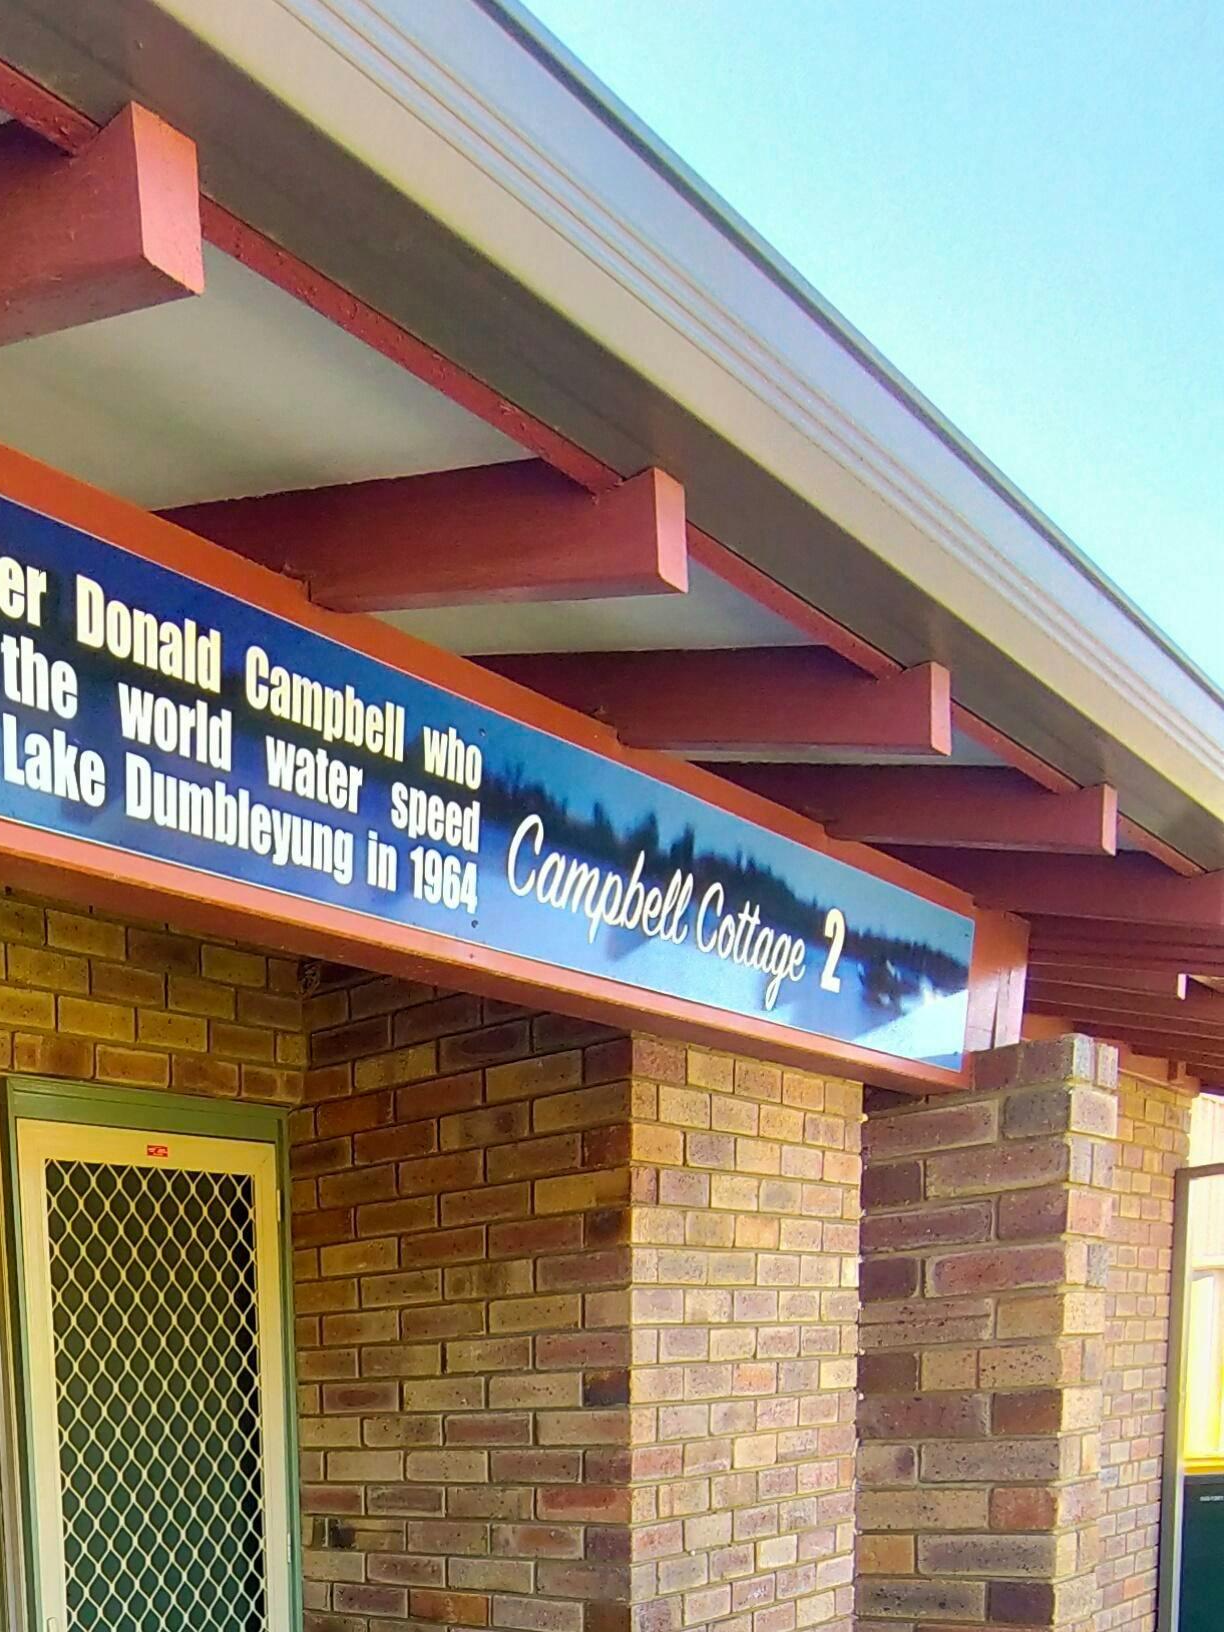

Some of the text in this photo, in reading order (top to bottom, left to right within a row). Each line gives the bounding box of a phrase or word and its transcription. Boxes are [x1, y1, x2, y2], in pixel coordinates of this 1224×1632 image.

[1, 634, 78, 719] the
[118, 682, 232, 772] world
[265, 736, 363, 814] water
[391, 781, 481, 854] speed
[76, 573, 221, 694] Donald
[245, 645, 404, 763] Campbell
[424, 726, 482, 791] who
[2, 712, 106, 808] Lake
[125, 752, 354, 885] Dumbleyung
[367, 831, 398, 892] in
[411, 845, 478, 914] 1964
[507, 814, 846, 1011] Campbell Cottage 2
